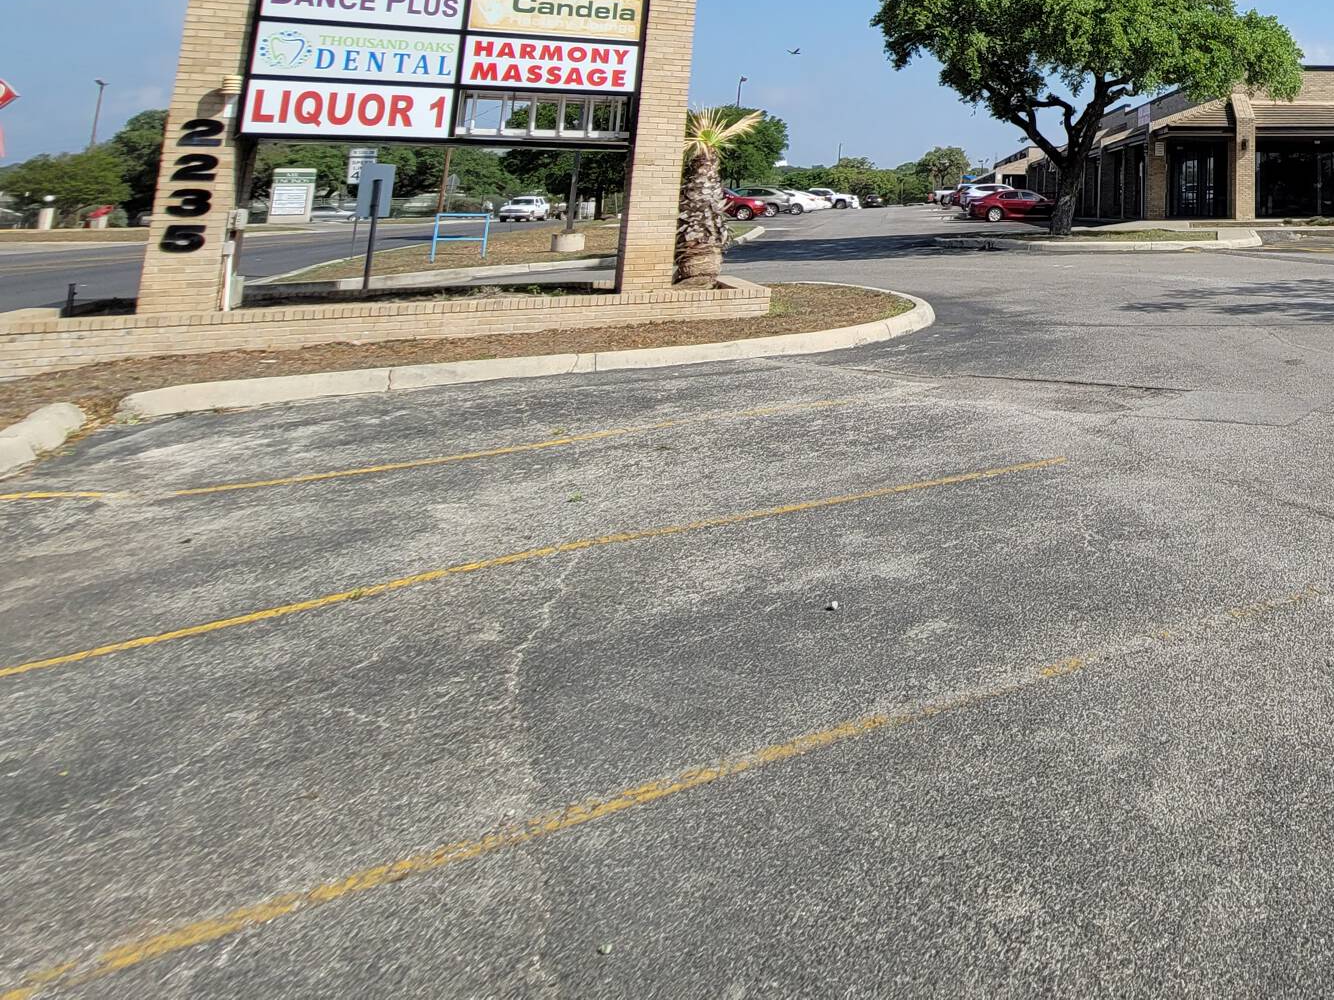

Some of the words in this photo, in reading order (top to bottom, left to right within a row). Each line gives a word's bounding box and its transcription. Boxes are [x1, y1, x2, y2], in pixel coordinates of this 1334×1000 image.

[319, 34, 409, 51] THOUSAND
[413, 40, 455, 53] OAKS
[473, 40, 630, 65] HARMONY
[314, 47, 451, 76] DENTAL
[469, 62, 627, 88] MASSAGE
[251, 88, 414, 128] LIQUOR
[429, 96, 446, 129] 1
